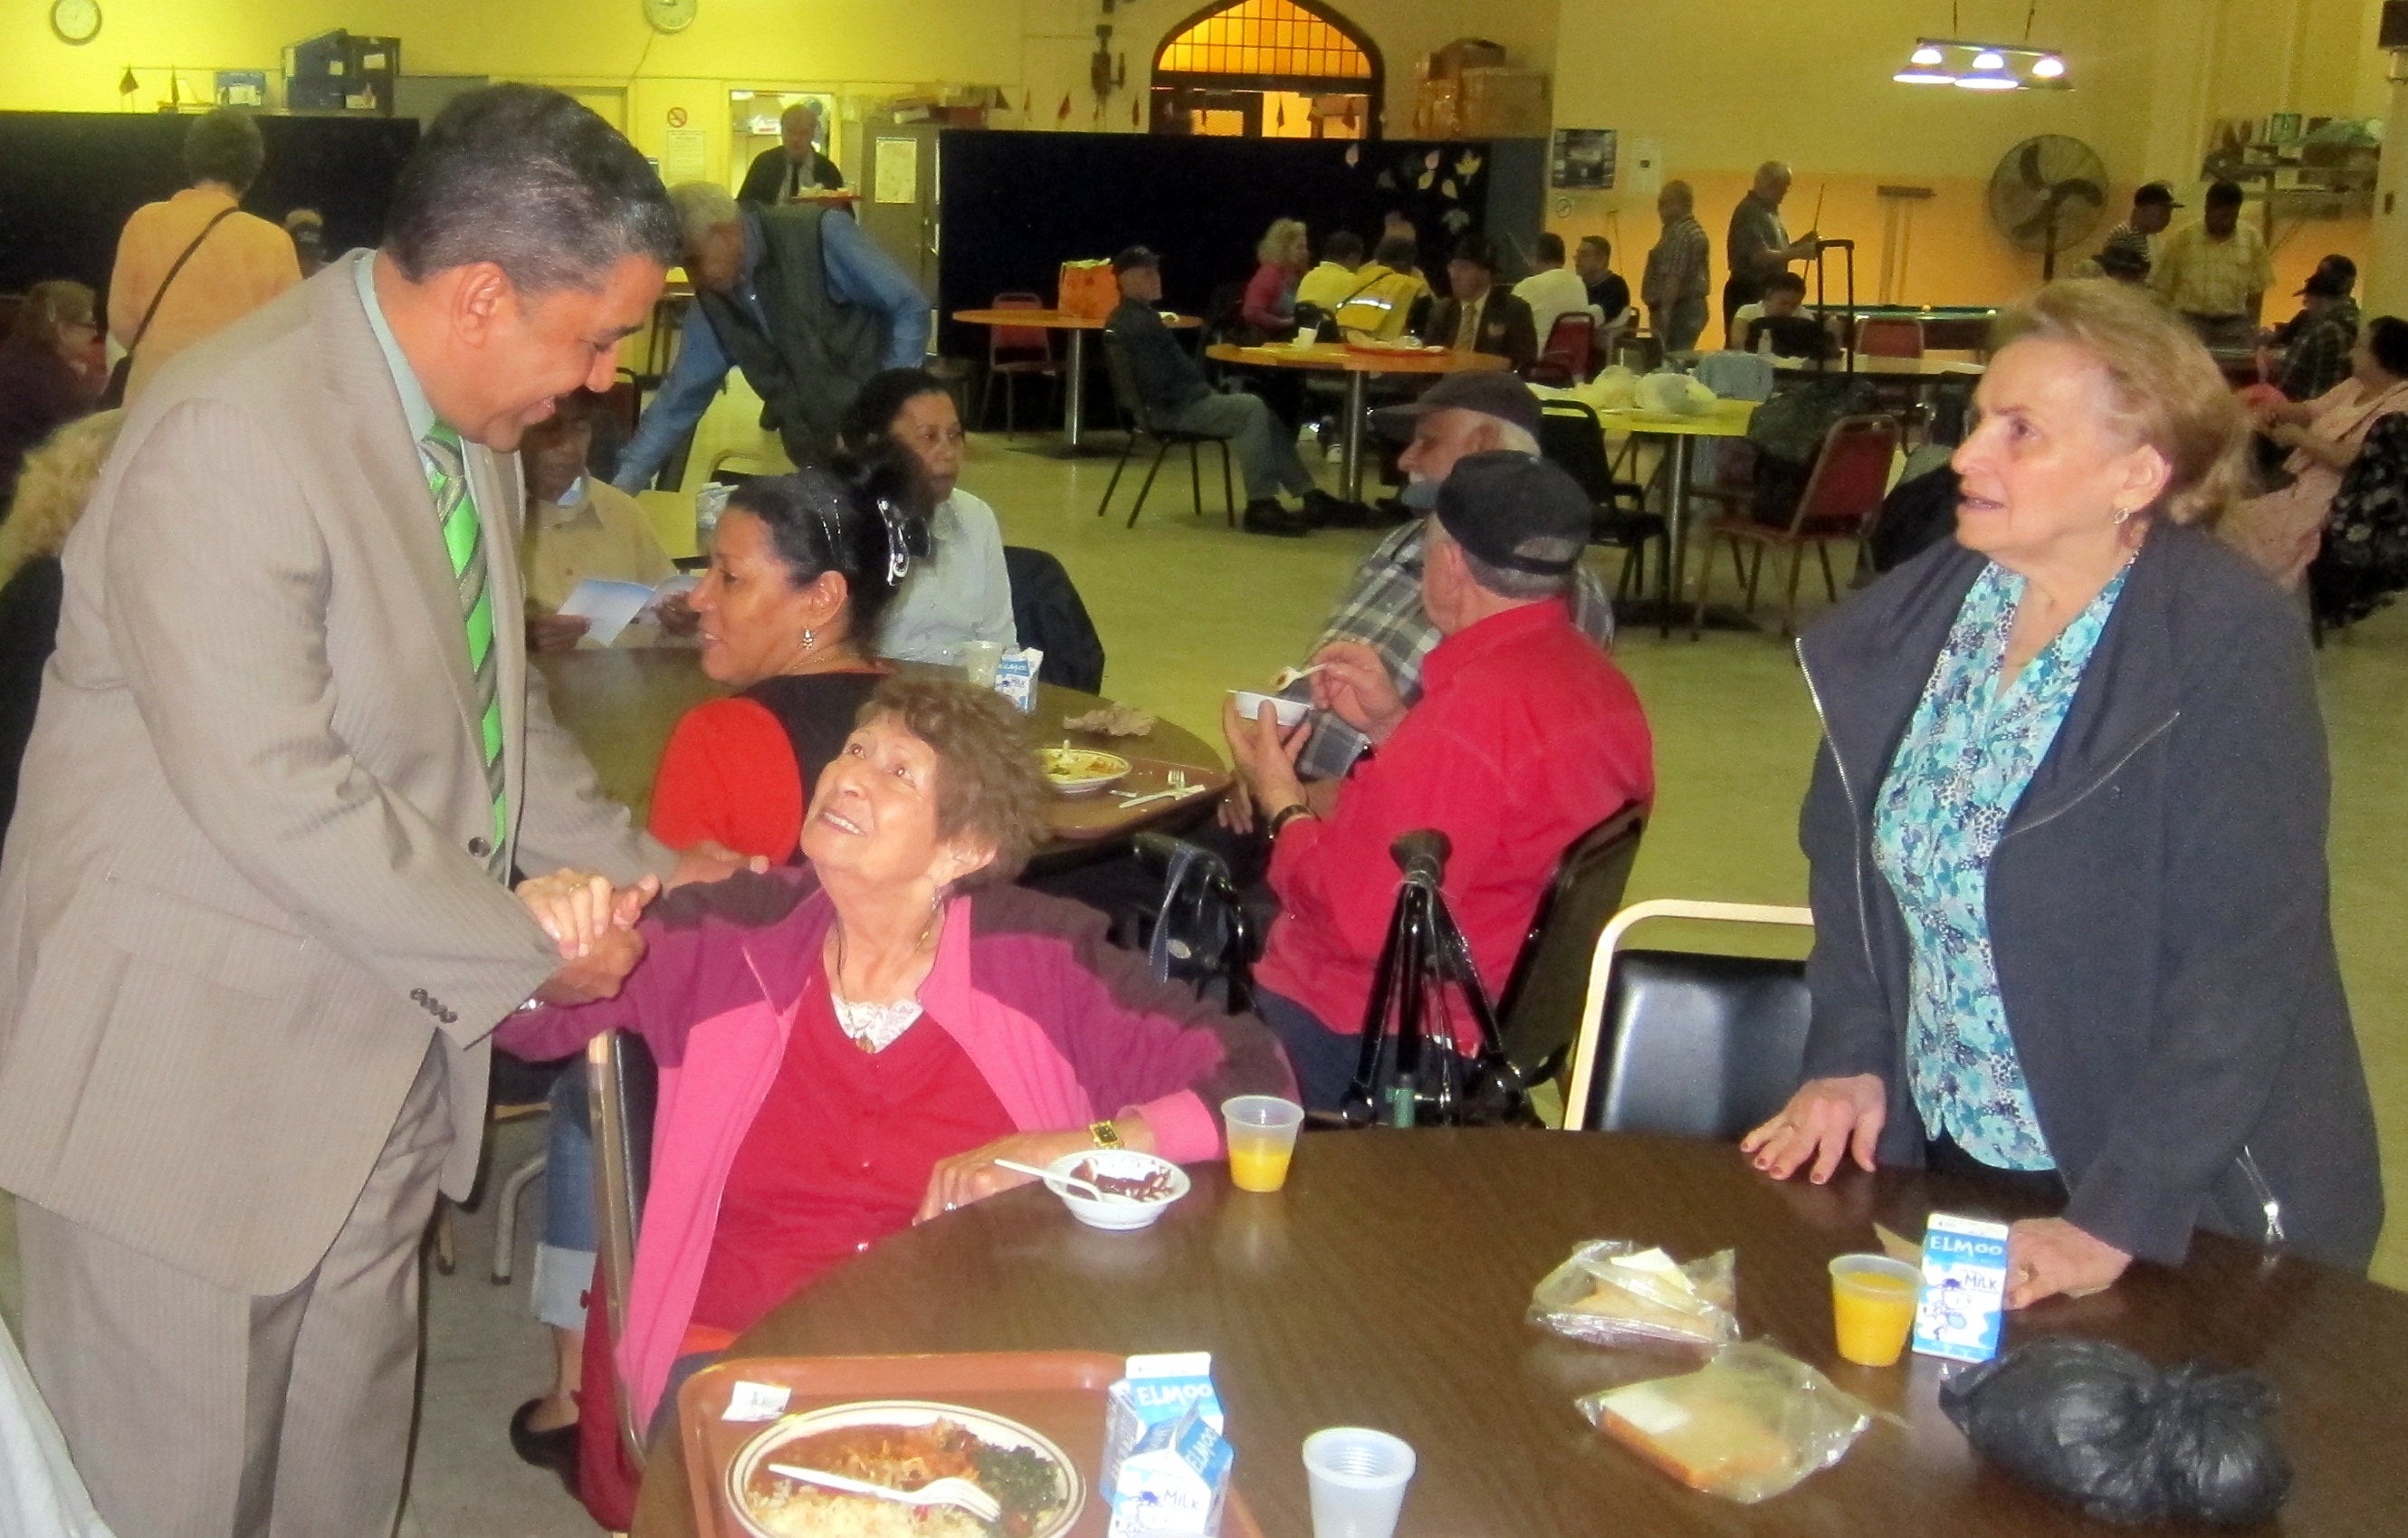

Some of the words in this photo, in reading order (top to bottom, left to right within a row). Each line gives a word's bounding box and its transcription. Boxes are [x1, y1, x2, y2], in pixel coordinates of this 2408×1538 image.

[1929, 1235, 2003, 1257] ELMOO
[1964, 1271, 1997, 1291] MILK
[1136, 1383, 1214, 1408] ELMOO
[1163, 1487, 1199, 1511] MILK
